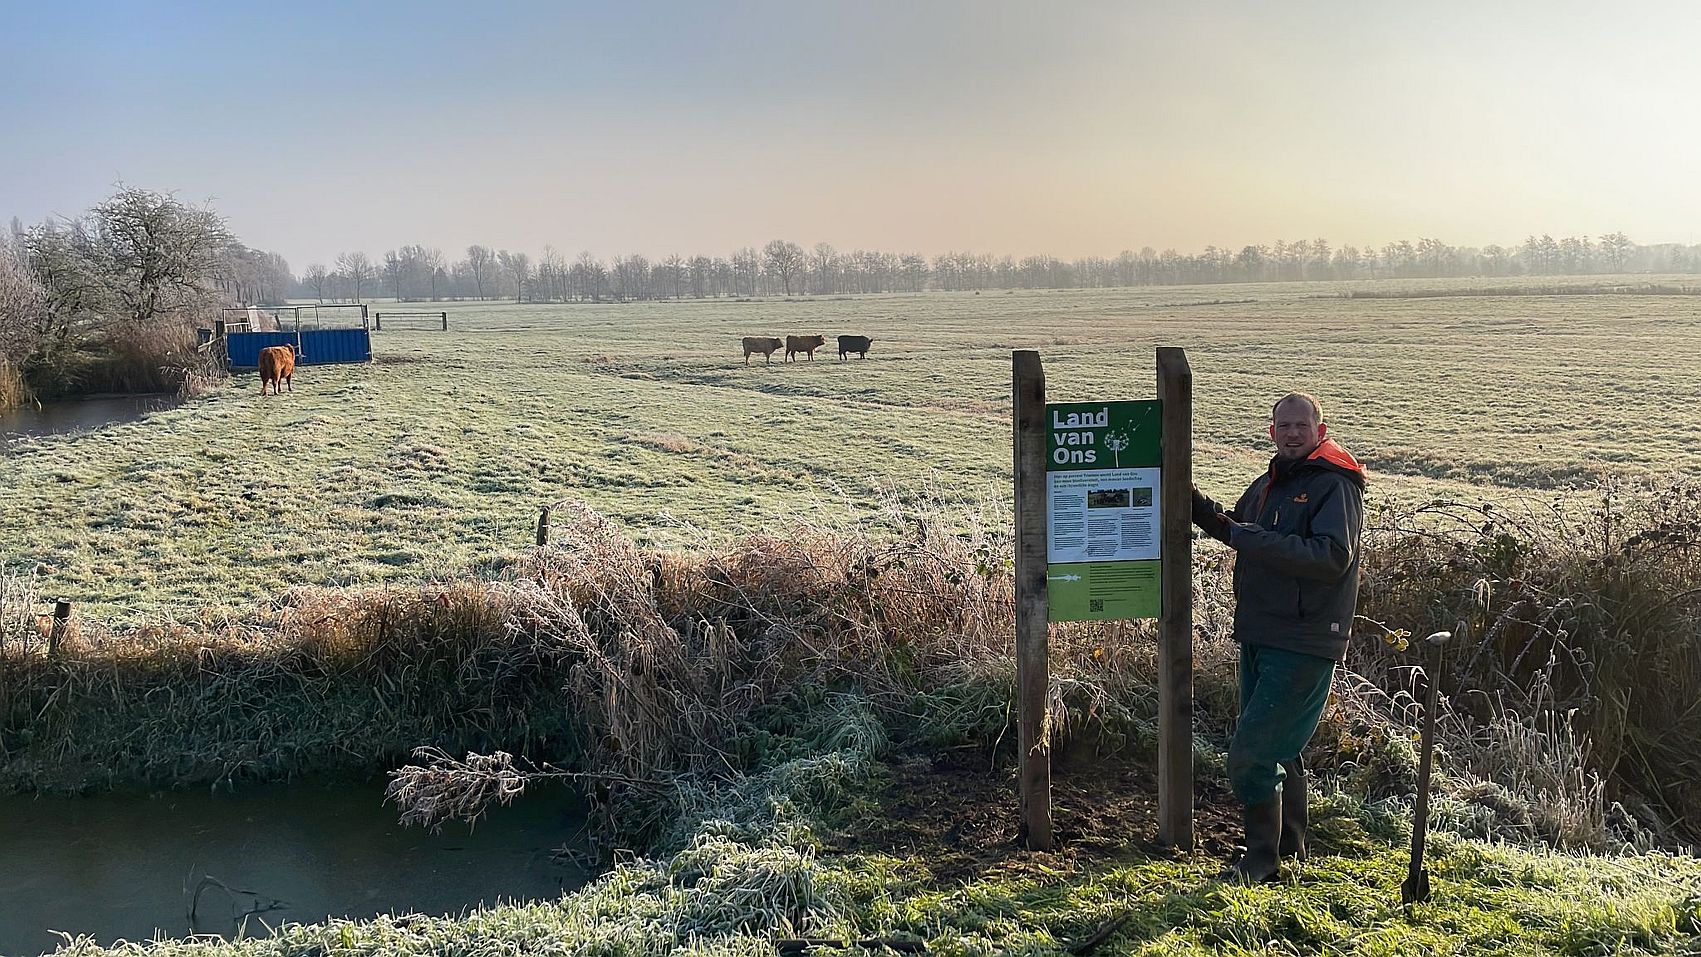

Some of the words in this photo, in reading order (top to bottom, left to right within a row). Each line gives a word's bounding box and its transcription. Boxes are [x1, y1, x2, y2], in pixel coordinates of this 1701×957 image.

[1053, 407, 1108, 428] Land
[1053, 431, 1094, 446] van
[1053, 447, 1097, 464] Ons
